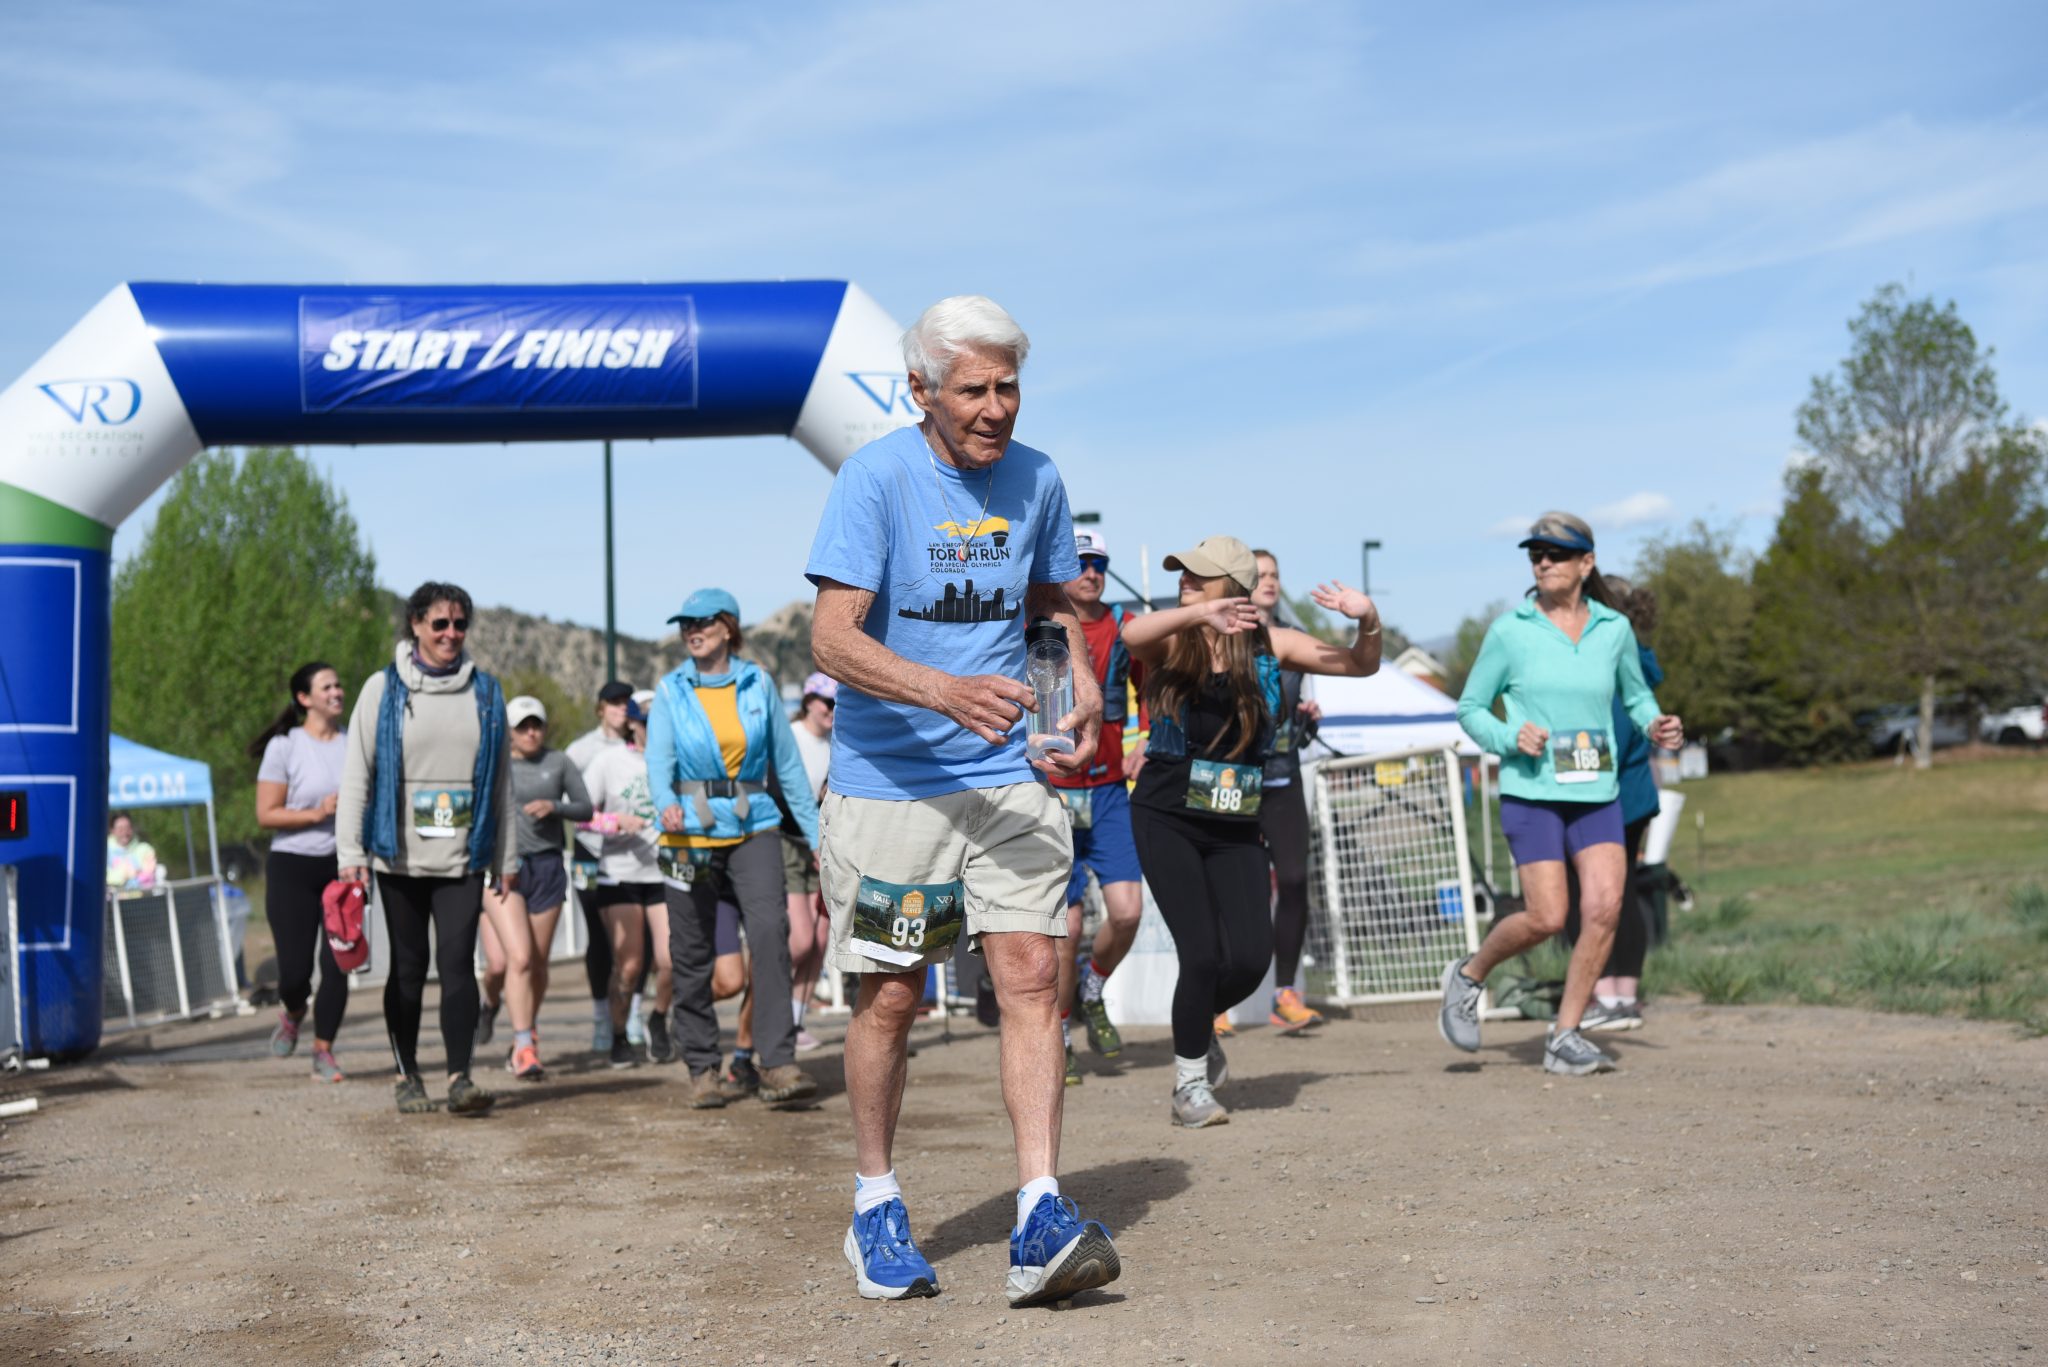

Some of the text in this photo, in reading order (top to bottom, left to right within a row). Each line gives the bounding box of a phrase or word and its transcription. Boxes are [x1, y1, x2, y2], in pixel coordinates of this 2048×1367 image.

[322, 329, 675, 371] START / FINISH
[1571, 748, 1601, 770] 168
[1210, 786, 1243, 811] 198
[433, 807, 454, 827] 92
[873, 893, 890, 905] VAIL
[891, 917, 927, 947] 93
